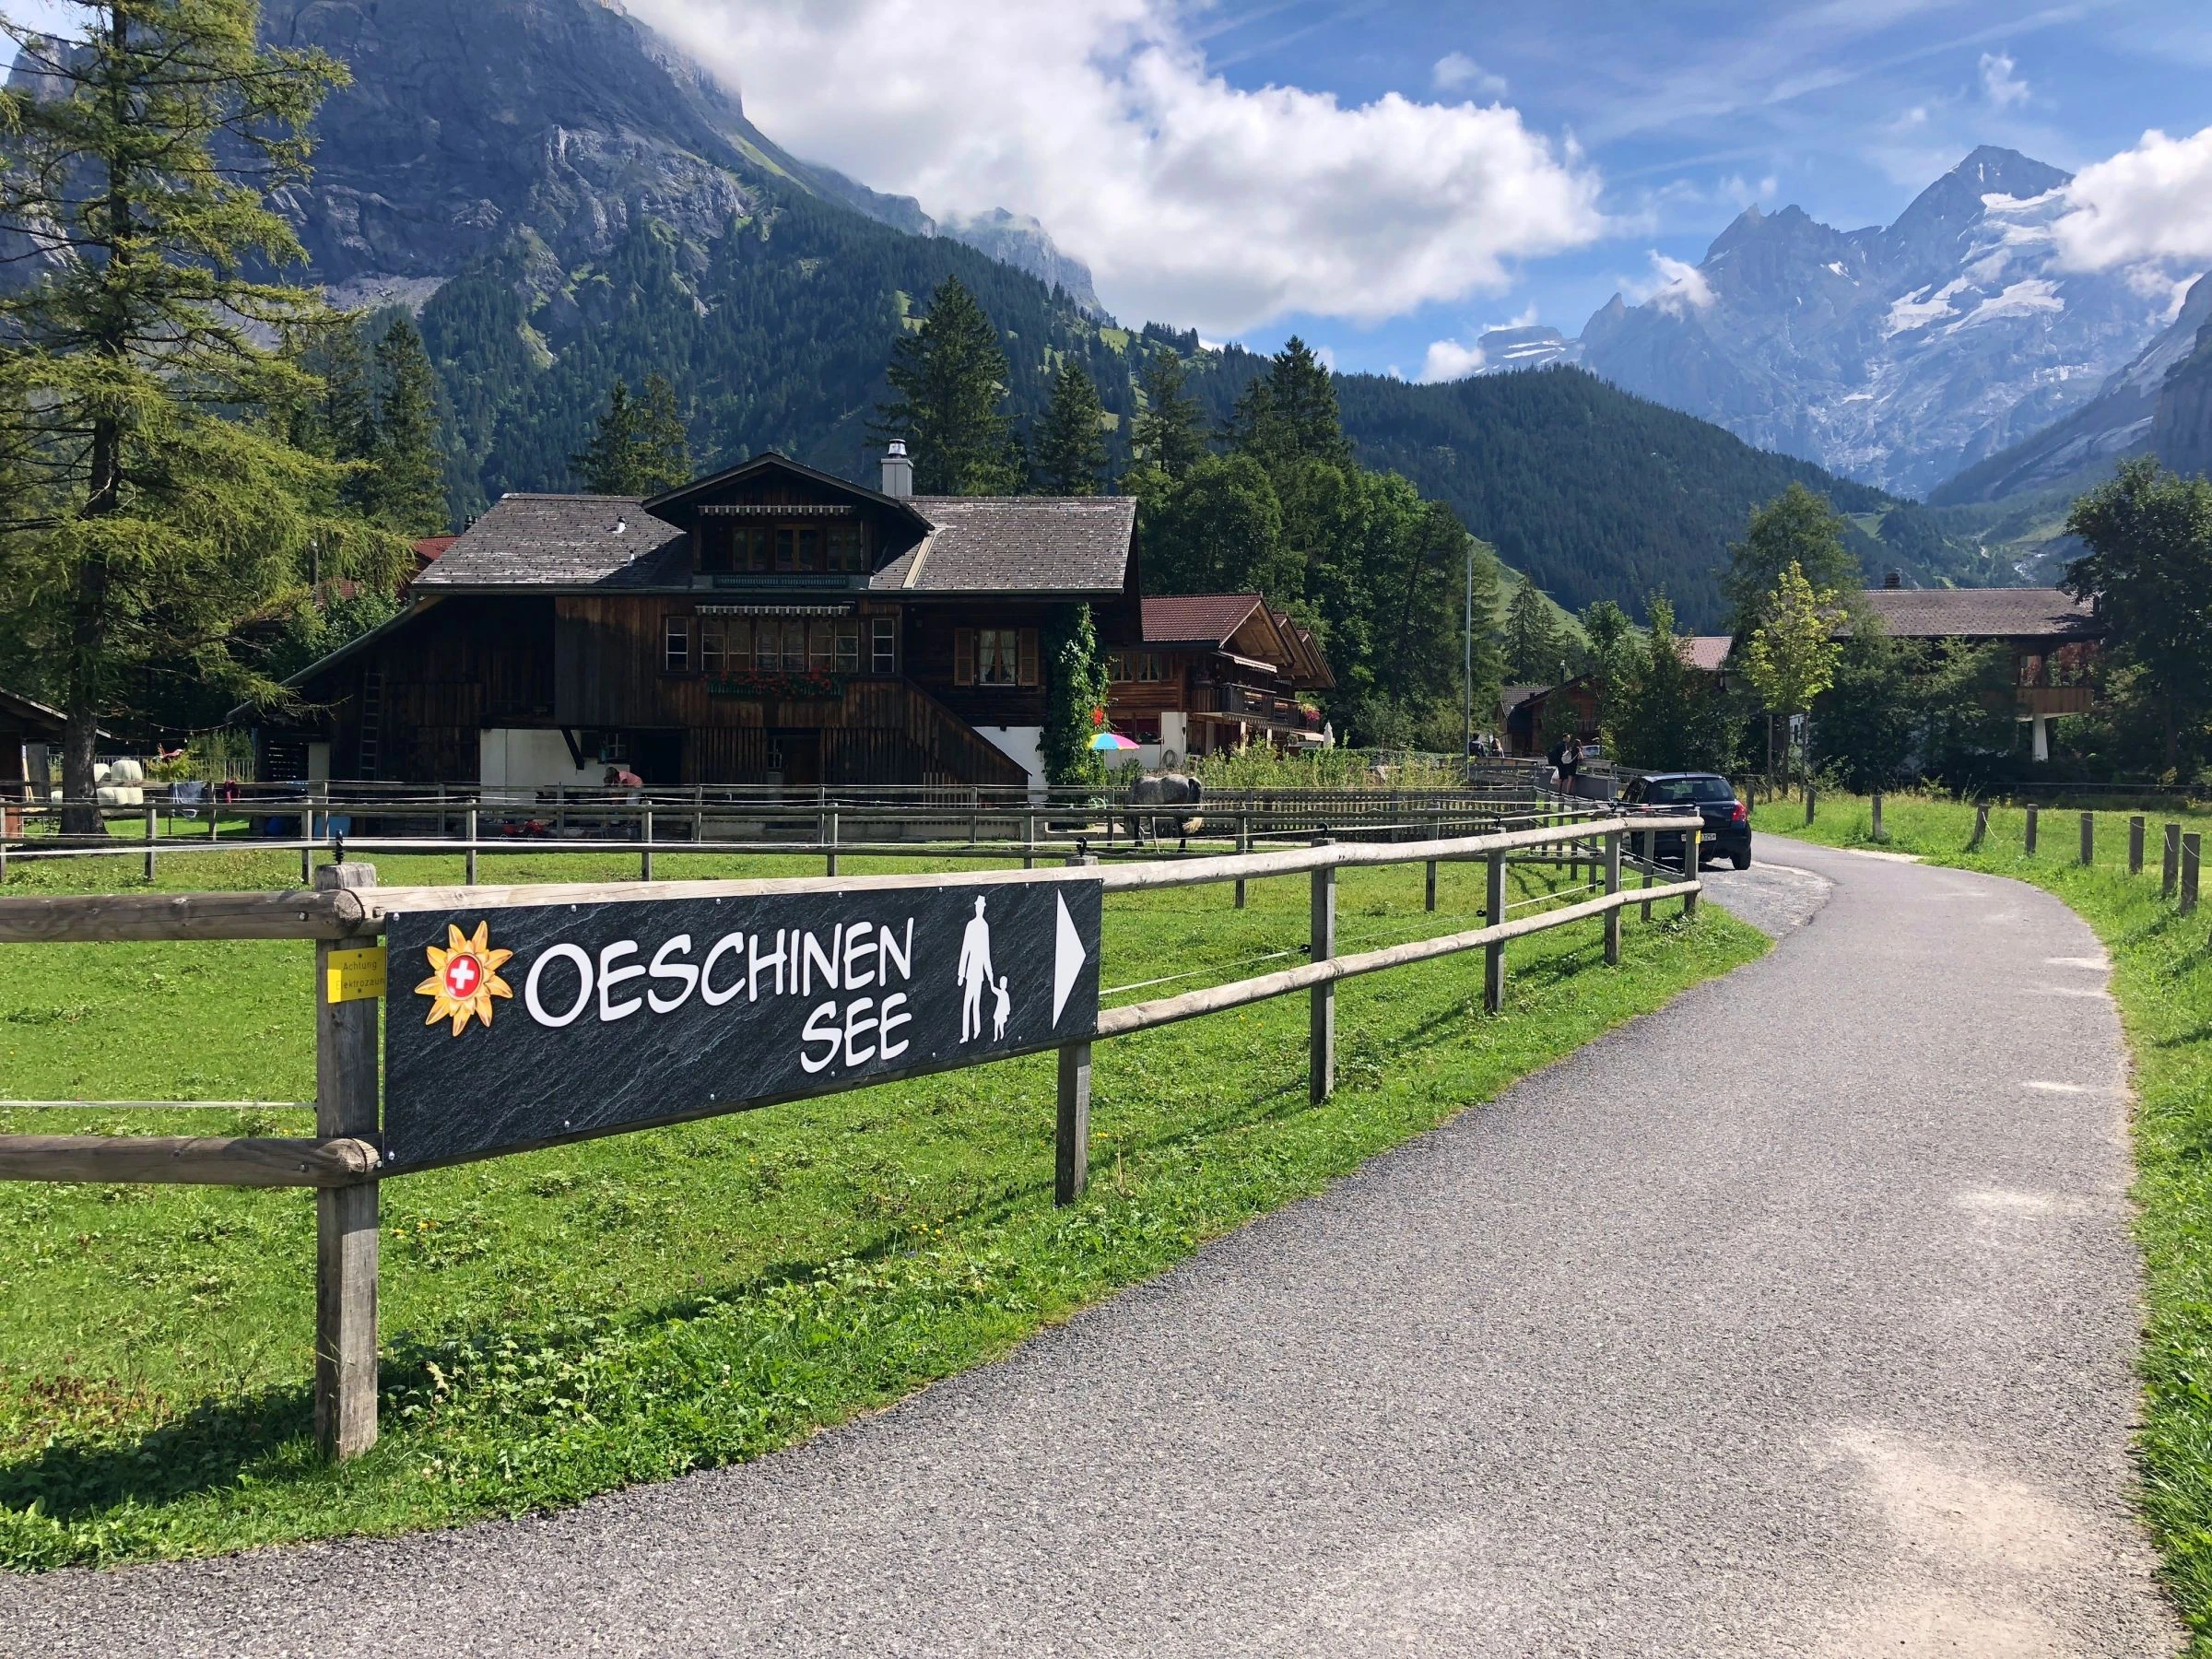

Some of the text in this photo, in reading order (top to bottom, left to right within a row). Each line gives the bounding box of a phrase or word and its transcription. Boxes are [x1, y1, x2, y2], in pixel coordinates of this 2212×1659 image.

[343, 961, 377, 971] Achtung
[524, 918, 914, 1028] OESCHINEN
[801, 992, 912, 1074] SEE
